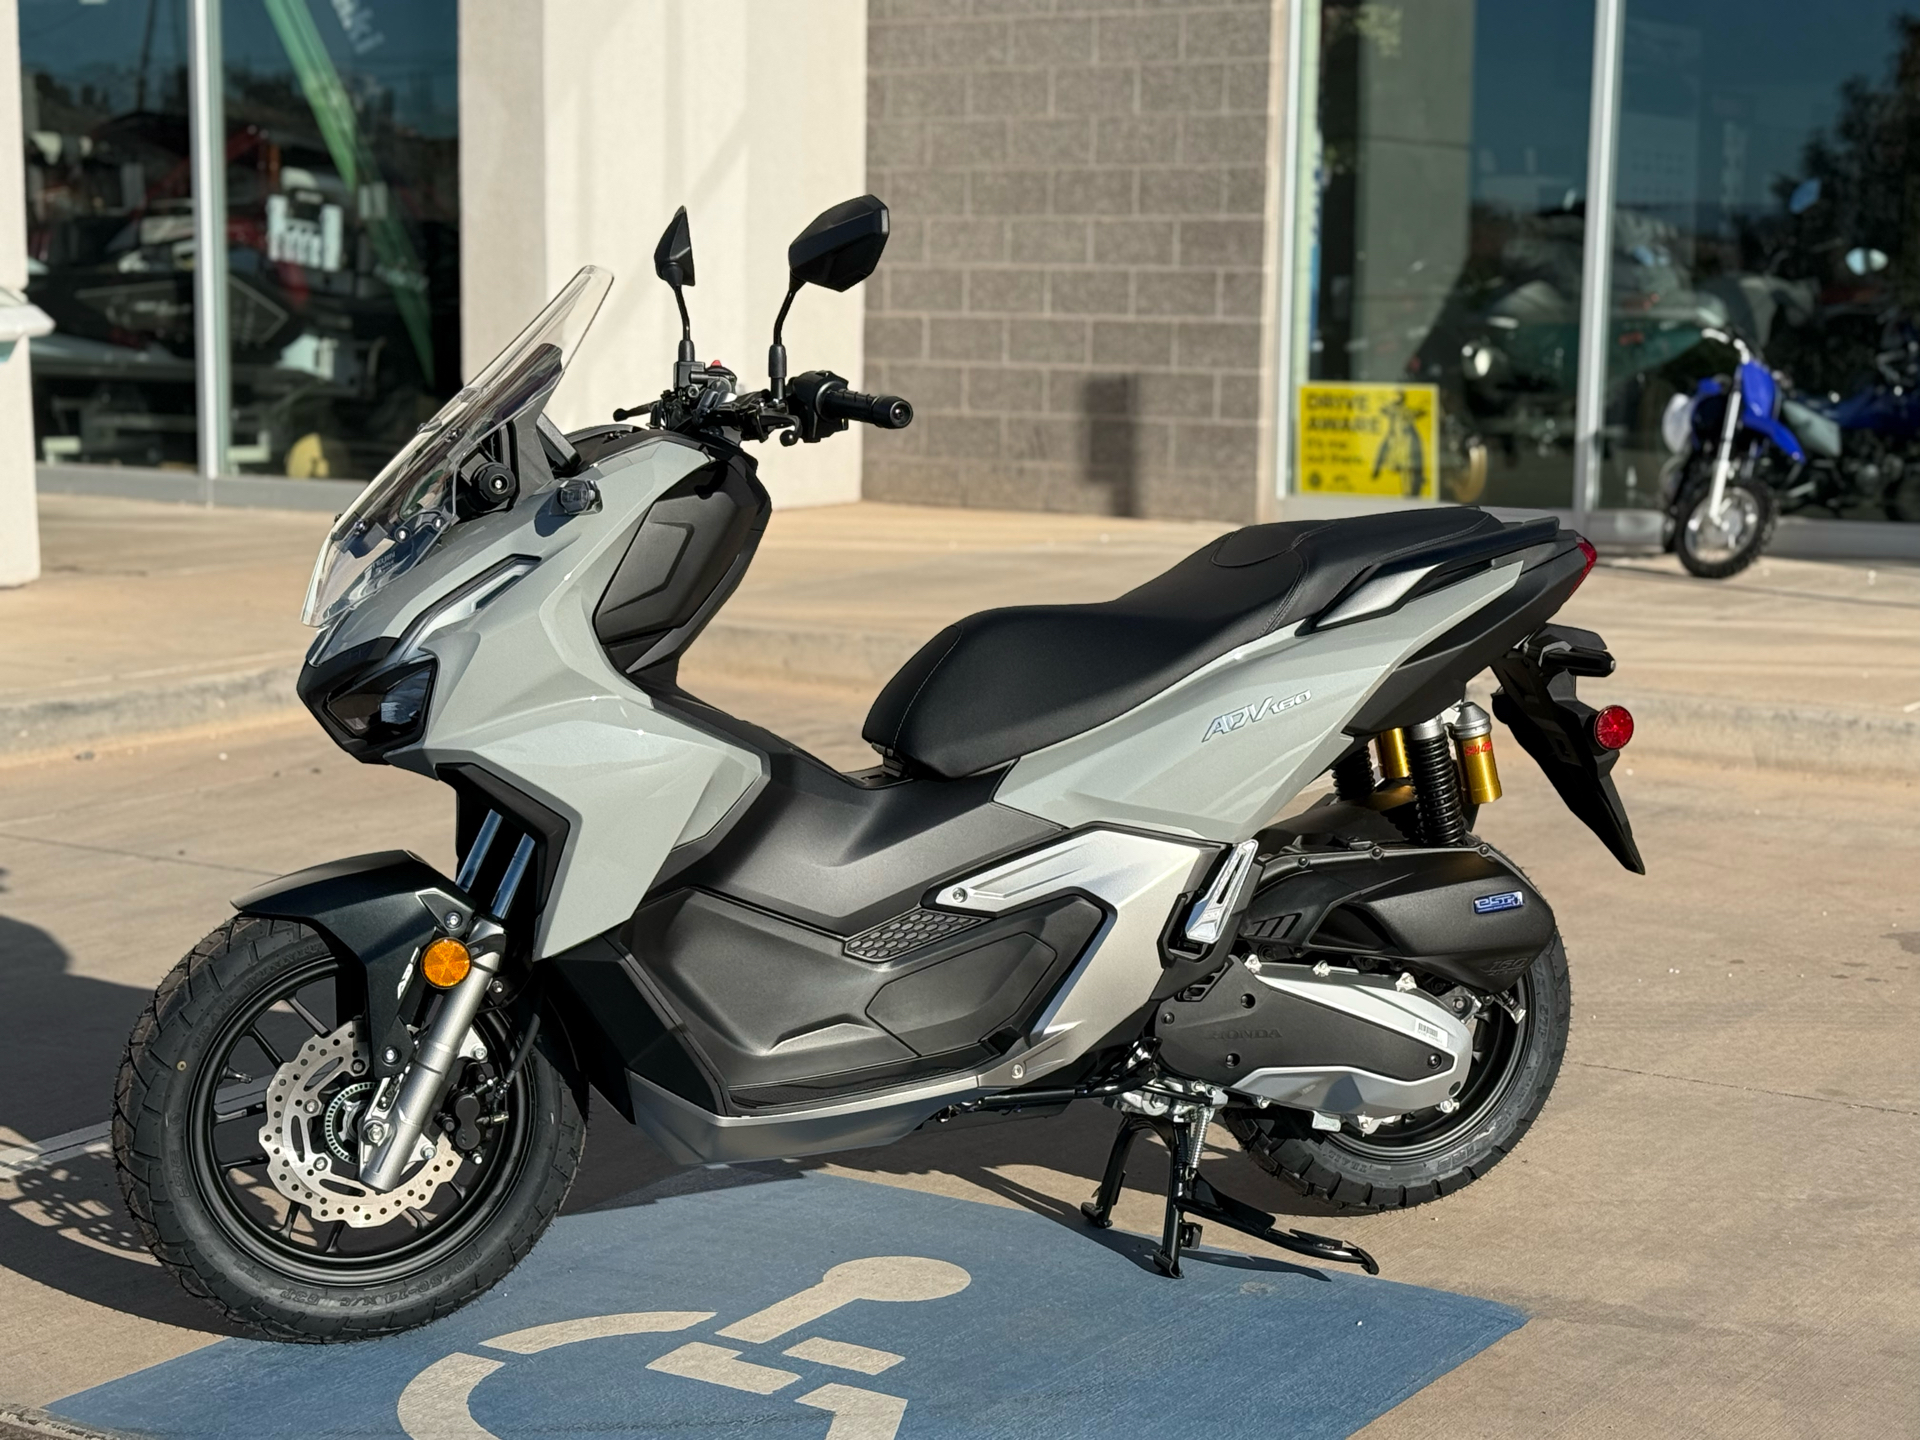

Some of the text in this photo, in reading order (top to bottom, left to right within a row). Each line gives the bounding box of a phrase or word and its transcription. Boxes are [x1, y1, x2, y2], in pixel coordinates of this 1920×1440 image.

[1306, 392, 1368, 412] DRIVE
[1307, 416, 1381, 434] AWARE
[1209, 1028, 1282, 1041] HONDA
